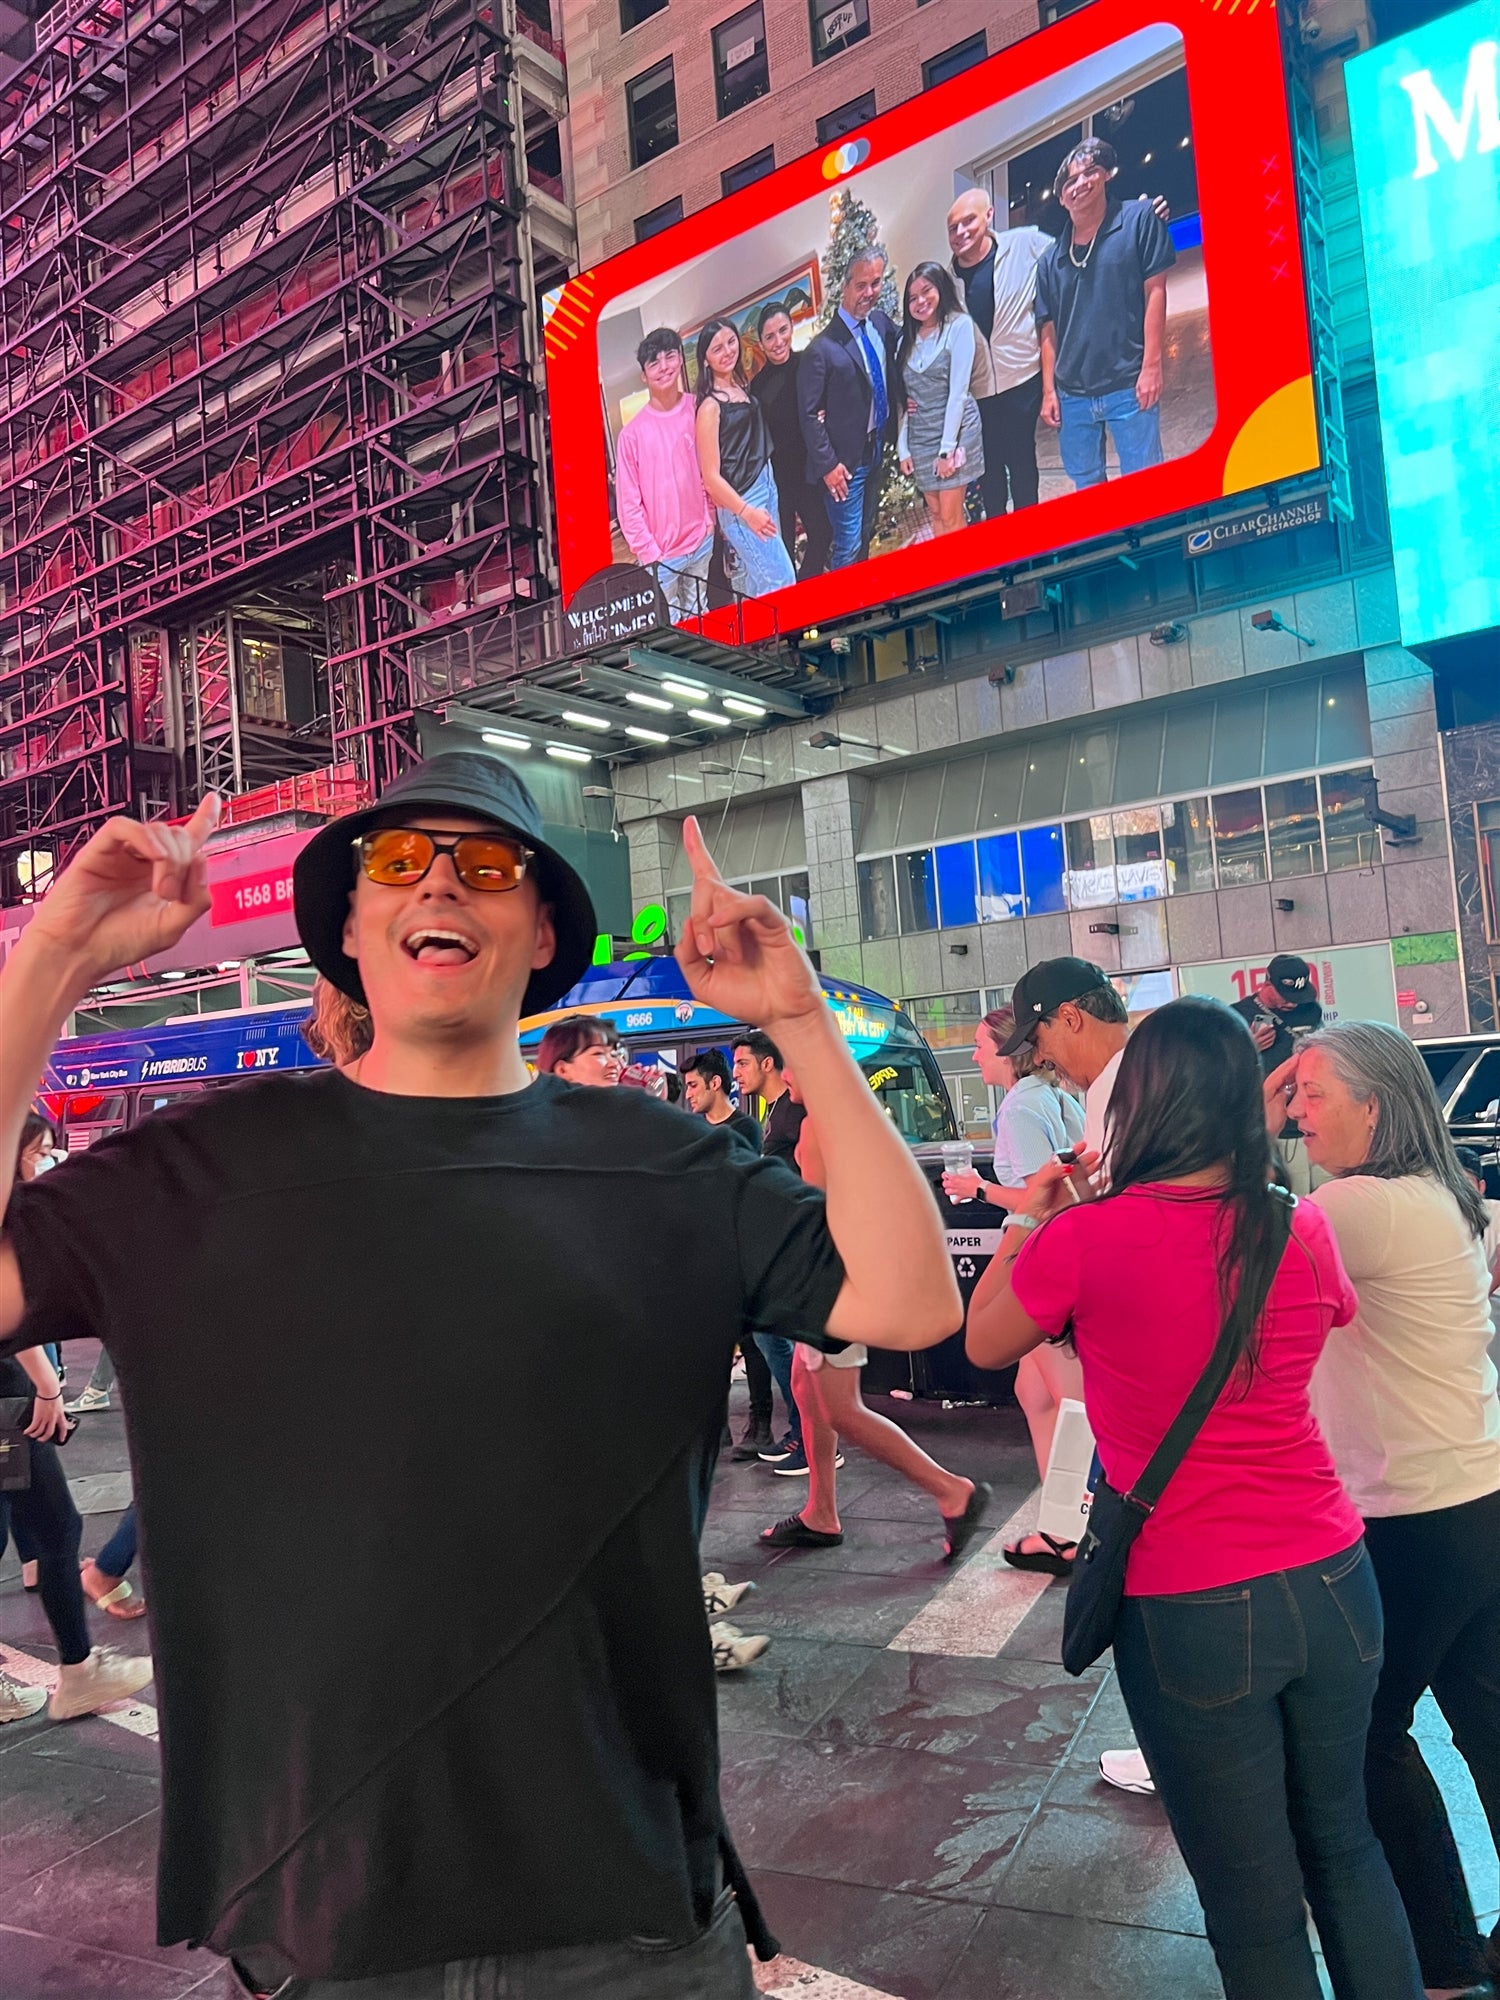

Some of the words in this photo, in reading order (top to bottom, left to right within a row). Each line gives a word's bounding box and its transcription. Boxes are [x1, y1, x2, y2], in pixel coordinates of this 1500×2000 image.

[235, 883, 271, 909] 1568
[1322, 961, 1335, 1005] BROADWAY
[626, 1012, 653, 1028] 9666
[148, 1056, 207, 1076] HYBRIDBUS
[947, 1236, 981, 1247] PAPER
